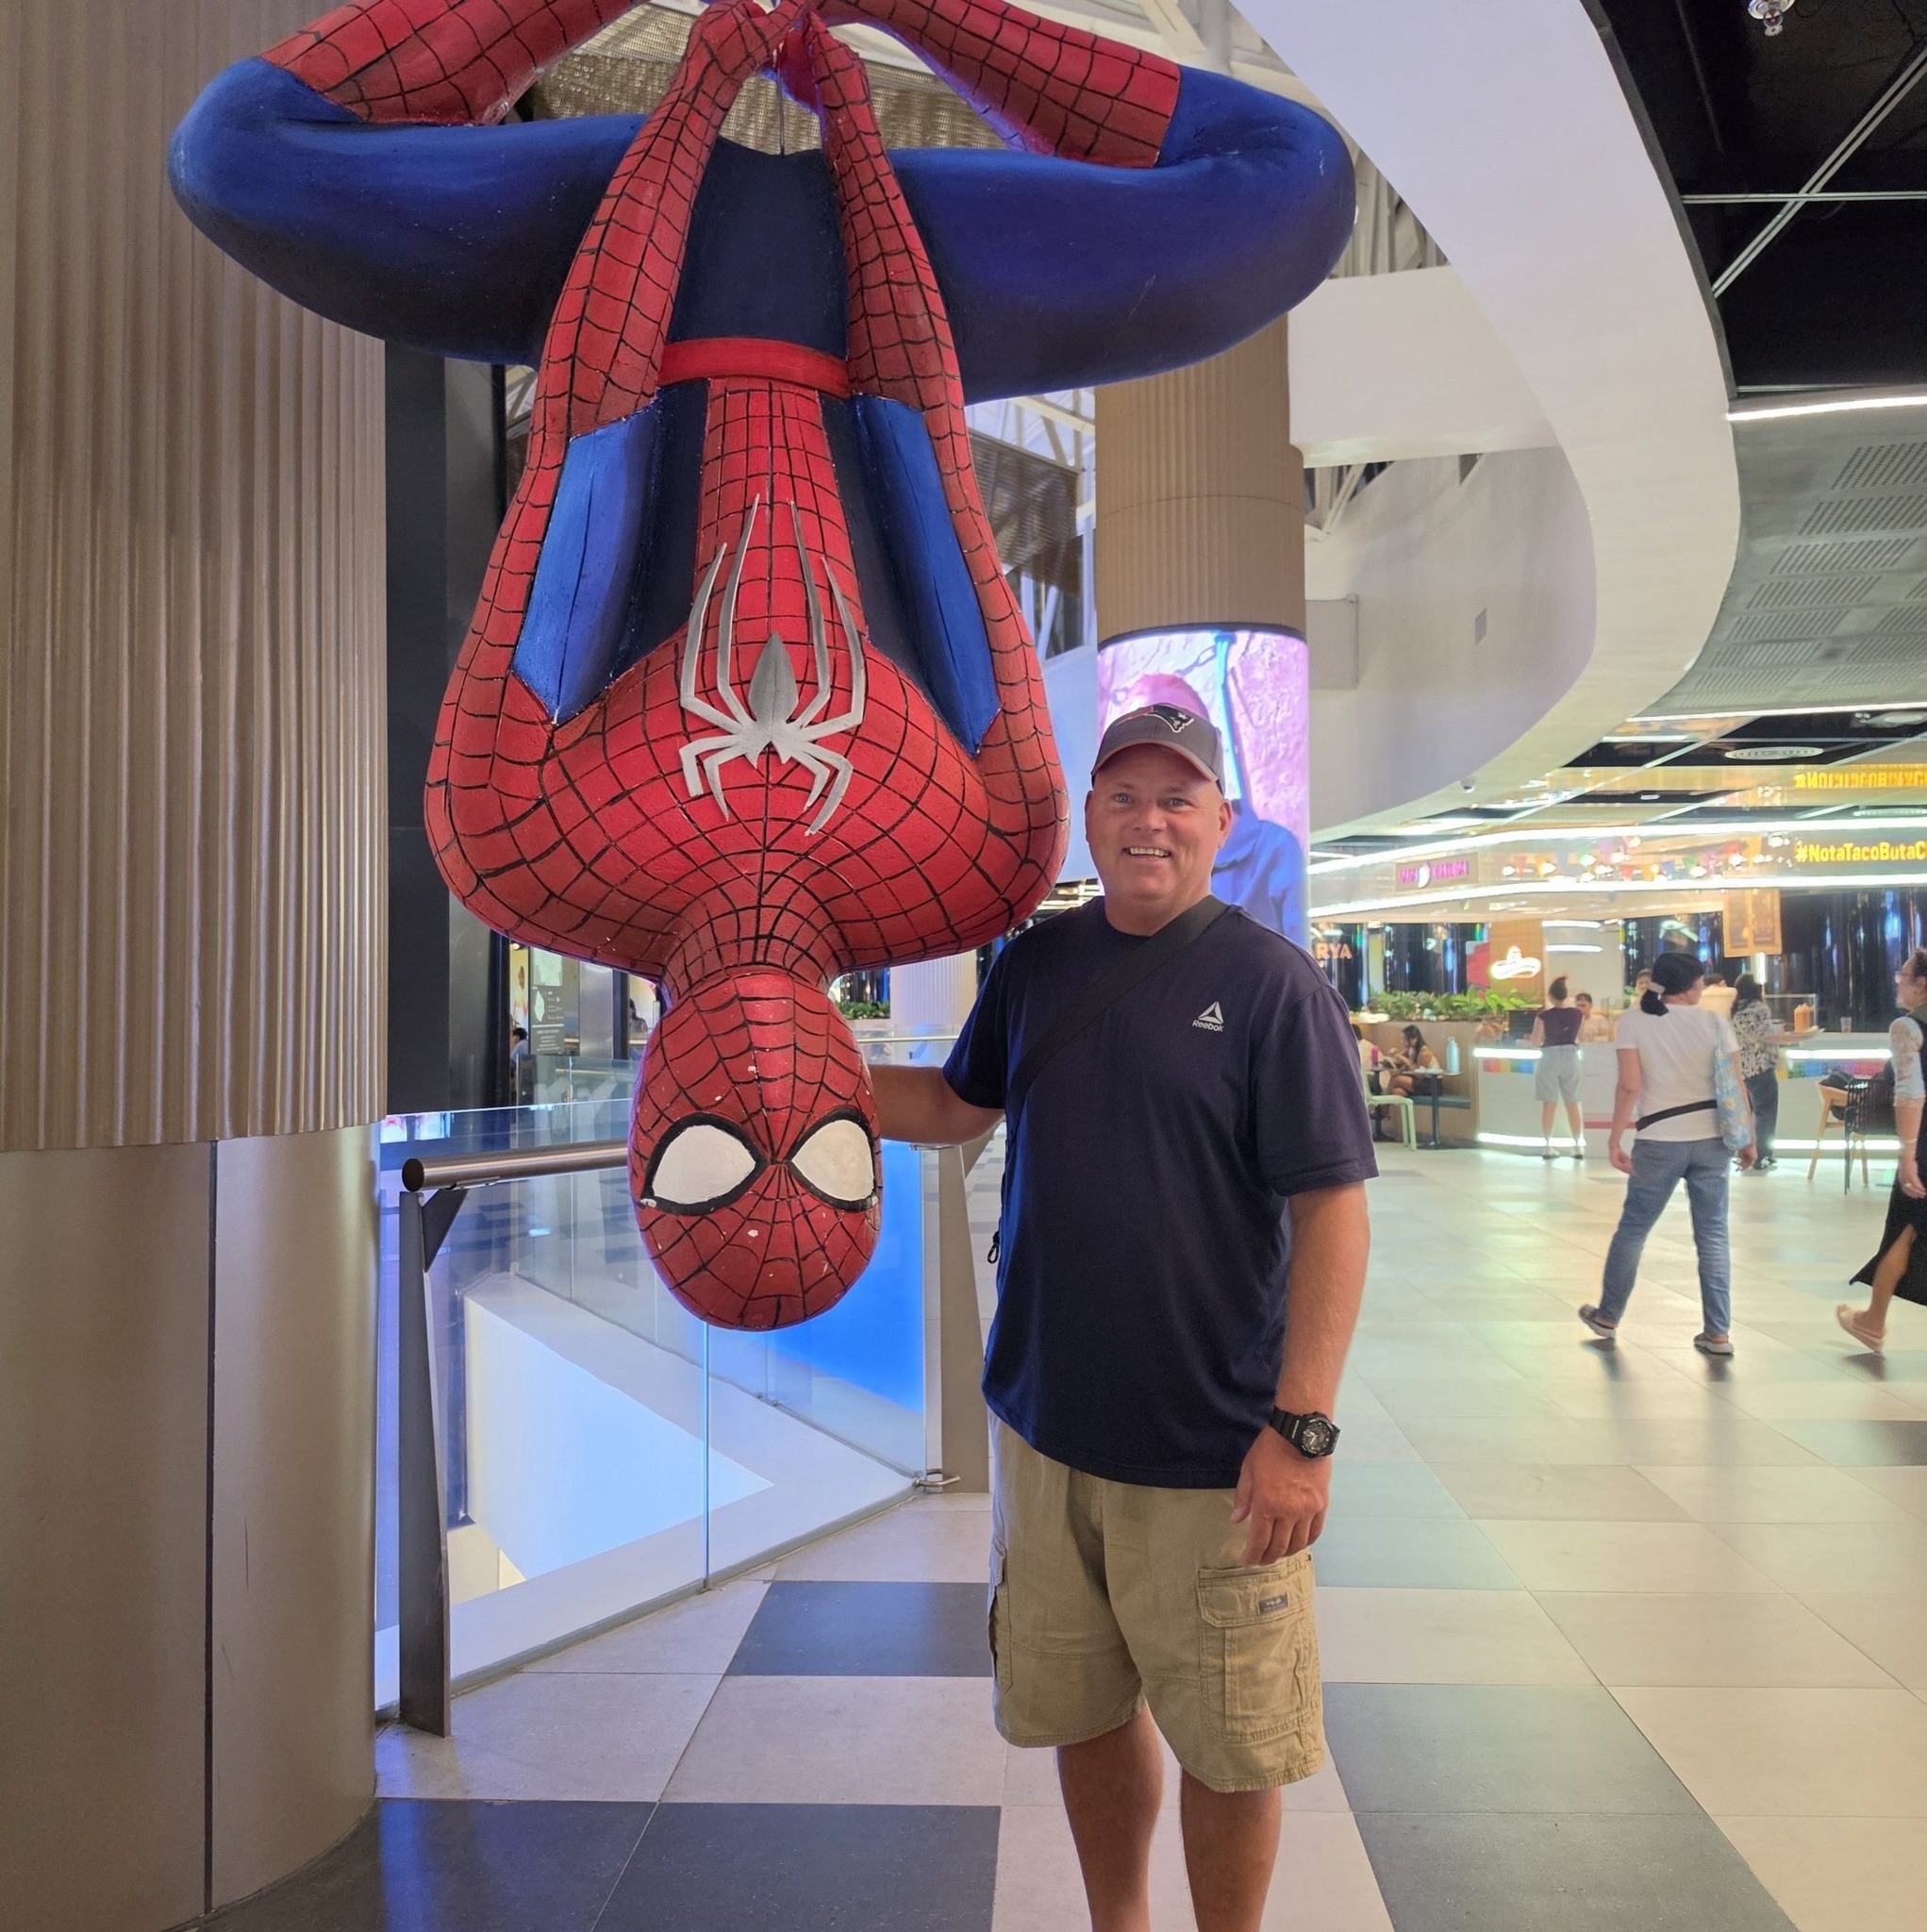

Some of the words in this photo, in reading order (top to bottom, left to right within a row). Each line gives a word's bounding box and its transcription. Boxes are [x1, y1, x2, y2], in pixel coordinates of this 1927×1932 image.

[1795, 841, 1927, 862] #NotaTacoButaC
[1314, 942, 1353, 959] RYA
[1192, 1020, 1224, 1032] Reebok
